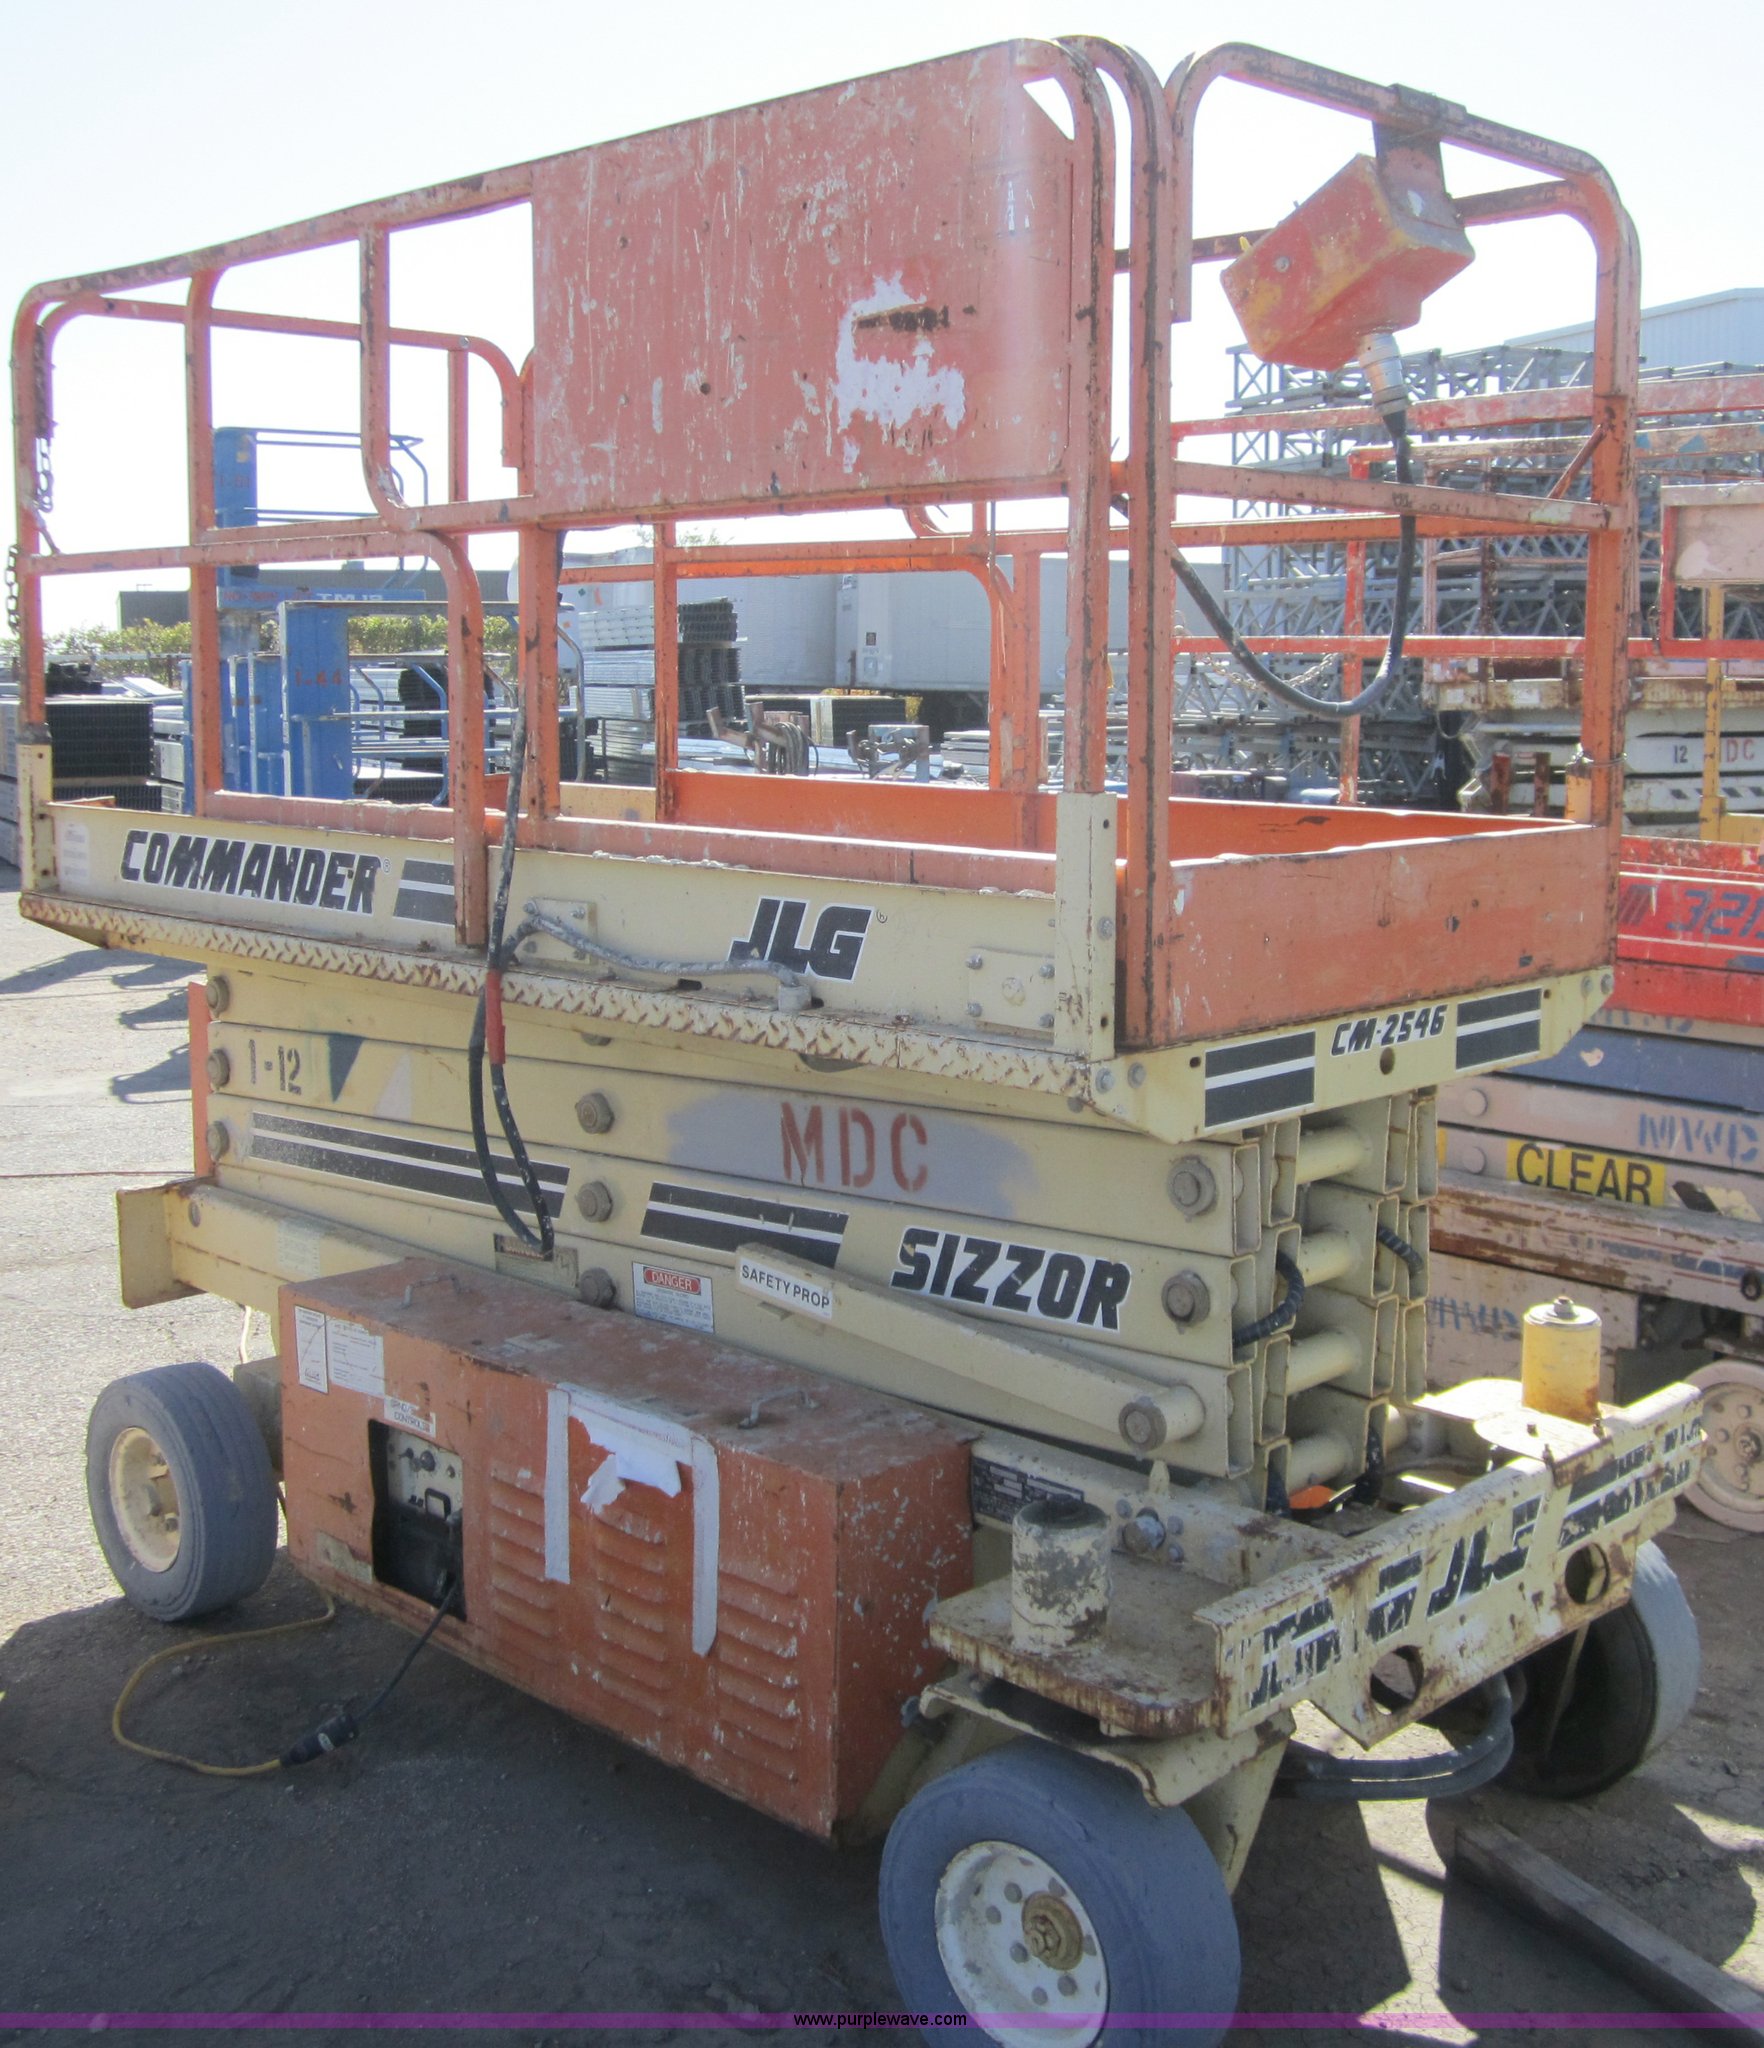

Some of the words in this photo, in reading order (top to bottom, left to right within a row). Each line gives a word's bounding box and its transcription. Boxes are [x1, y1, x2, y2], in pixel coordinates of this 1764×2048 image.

[1673, 745, 1689, 763] 12
[120, 829, 382, 914] COMMANDER
[729, 897, 873, 981] JLG
[1666, 888, 1764, 940] 321
[1331, 1003, 1449, 1056] CM-2546
[780, 1101, 929, 1193] MDC
[1516, 1142, 1653, 1206] CLEAR
[651, 1270, 693, 1291] DANGER
[741, 1264, 791, 1294] SAFETY
[792, 1284, 831, 1309] PROP
[891, 1227, 1131, 1331] SIZZOR
